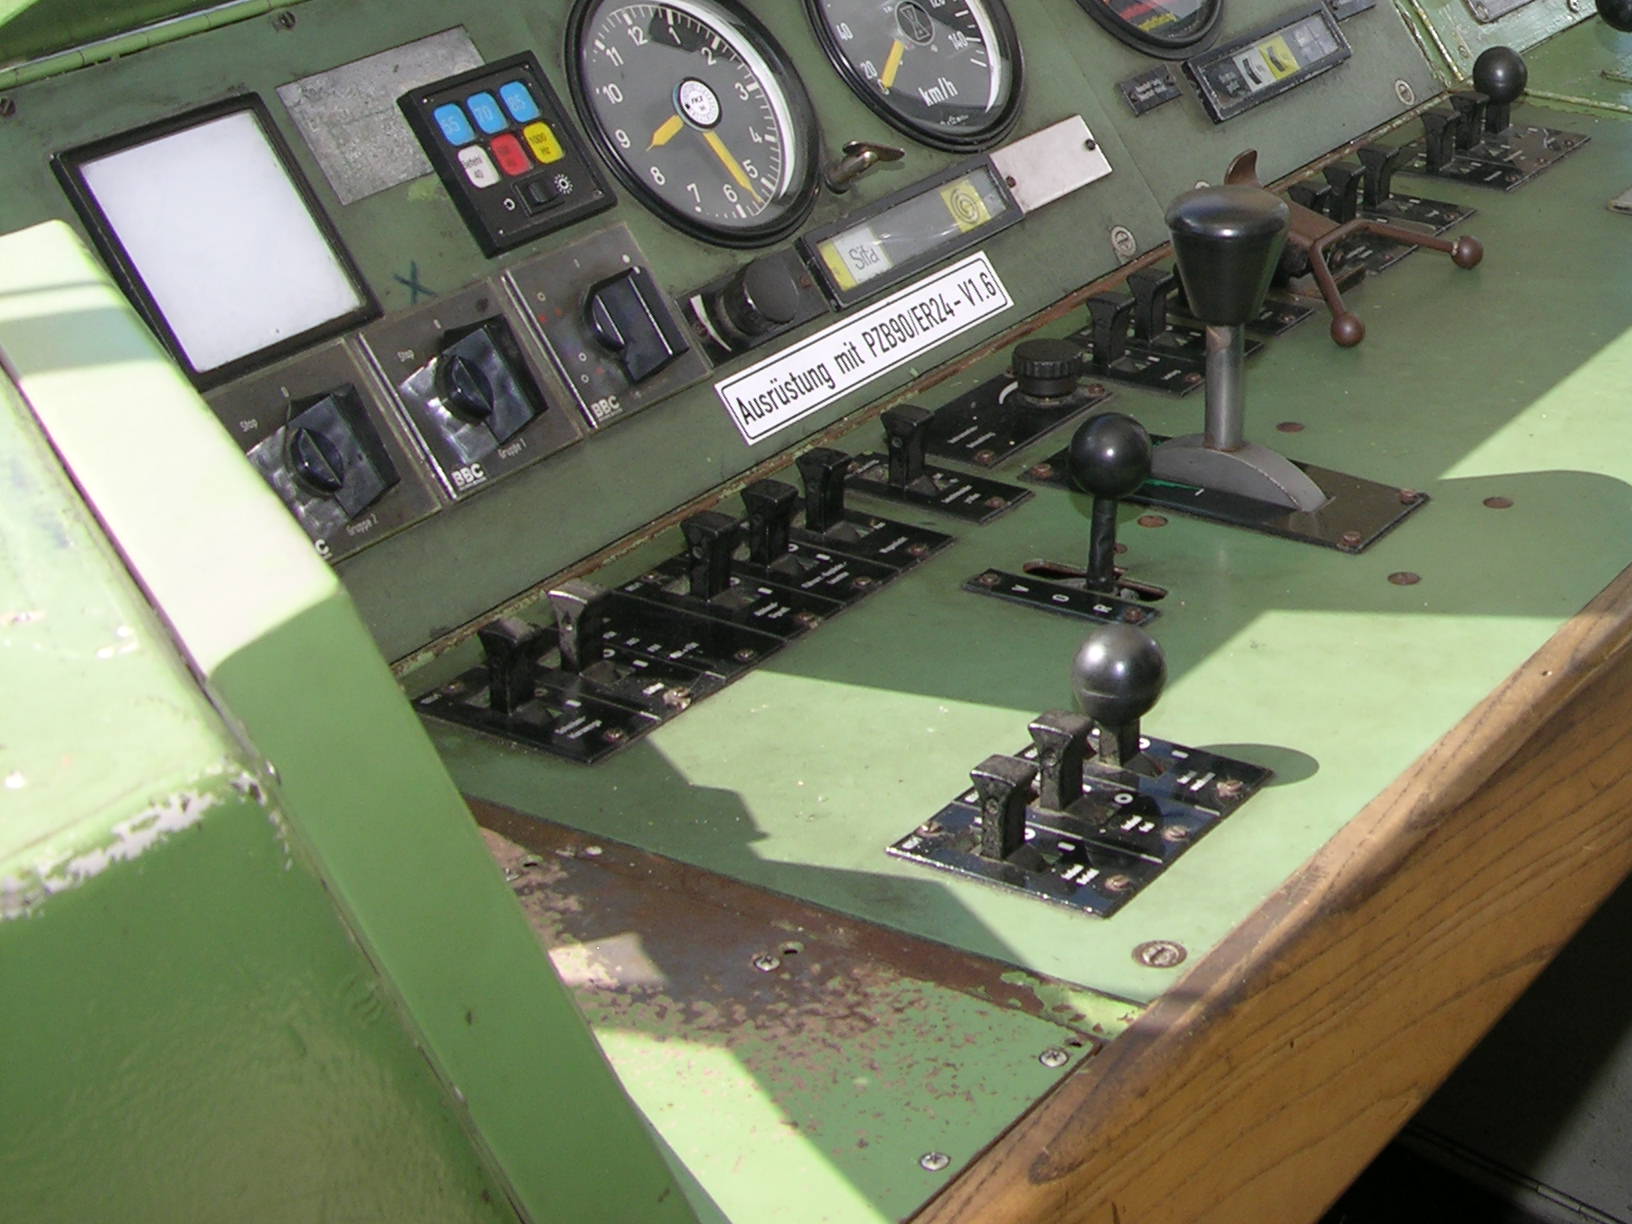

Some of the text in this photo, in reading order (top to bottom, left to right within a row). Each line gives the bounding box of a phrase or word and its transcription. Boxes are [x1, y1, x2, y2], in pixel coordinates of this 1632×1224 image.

[627, 26, 648, 46] 12
[669, 27, 681, 45] 1
[836, 23, 853, 41] 40
[948, 31, 968, 51] 140
[606, 47, 624, 67] 11
[701, 47, 717, 66] 2
[860, 61, 878, 80] 20
[602, 83, 624, 104] 10
[735, 82, 750, 101] 3
[918, 77, 958, 107] km/h
[474, 105, 494, 122] 70
[615, 129, 631, 149] 9
[749, 126, 763, 145] 4
[650, 167, 666, 186] 8
[743, 159, 758, 178] 5
[687, 183, 701, 203] 7
[723, 184, 738, 203] 6
[848, 246, 880, 270] Sifa
[736, 363, 836, 426] Ausrüstung
[834, 340, 865, 374] mit
[591, 396, 620, 417] BBC
[451, 463, 484, 487] BBC
